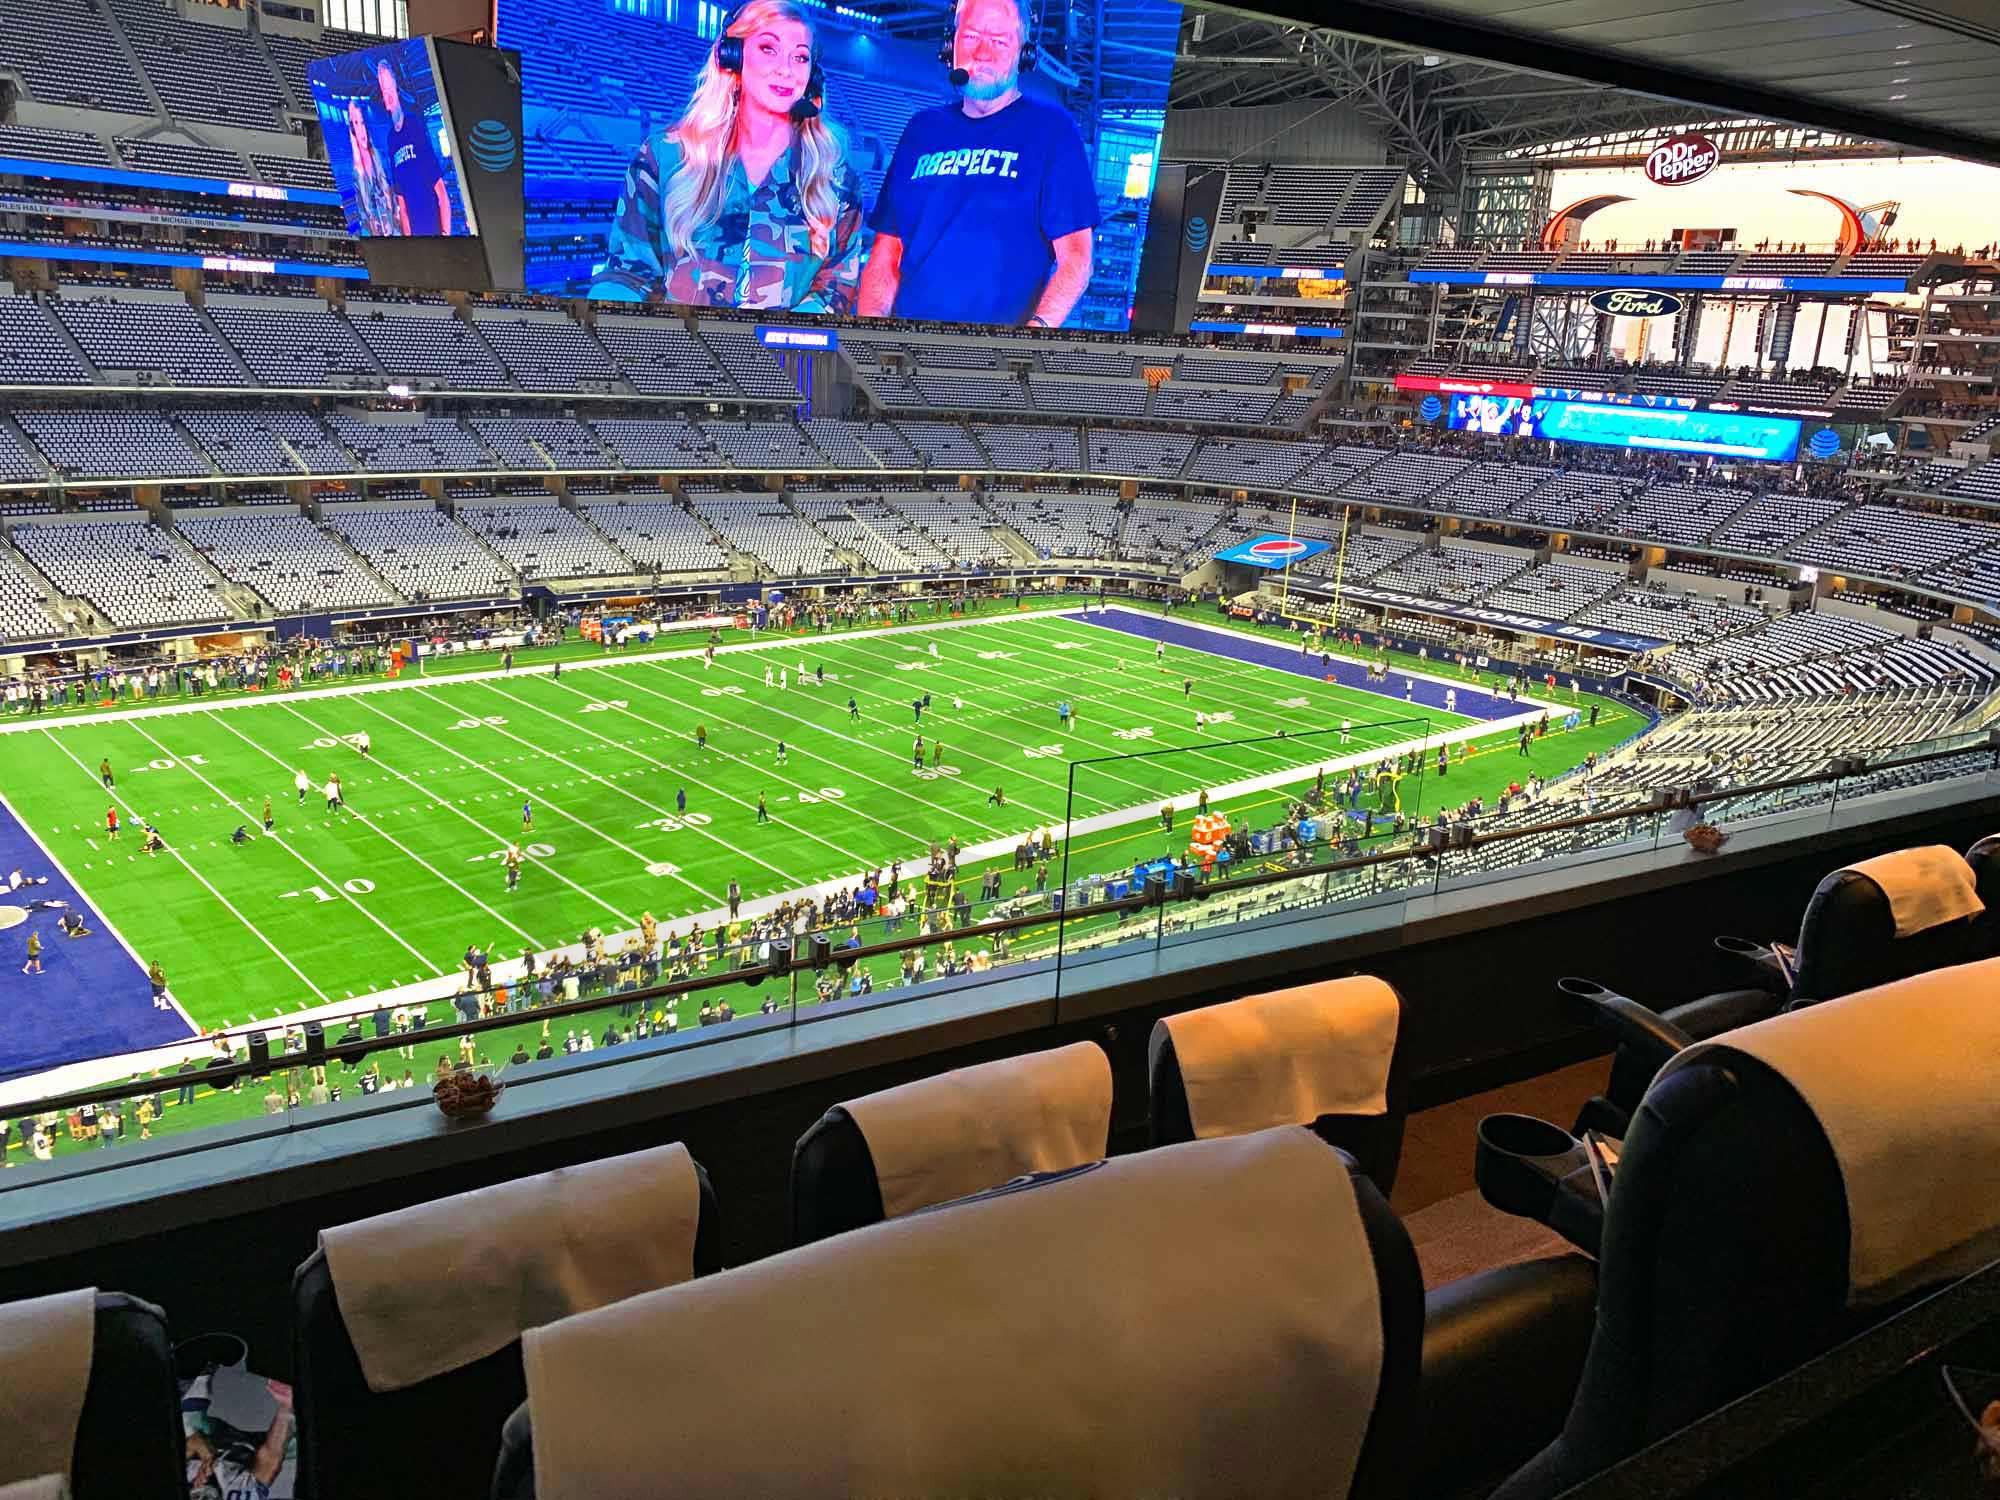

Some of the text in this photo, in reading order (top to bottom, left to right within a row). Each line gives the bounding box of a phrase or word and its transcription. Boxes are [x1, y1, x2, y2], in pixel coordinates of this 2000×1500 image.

[1672, 142, 1698, 162] Dr
[161, 216, 194, 225] MICHAEL
[1607, 291, 1663, 314] Ford
[1319, 581, 1456, 611] WELCOME
[1454, 606, 1552, 629] HOME
[798, 787, 846, 804] 40
[651, 812, 713, 832] 30
[302, 878, 376, 904] 10
